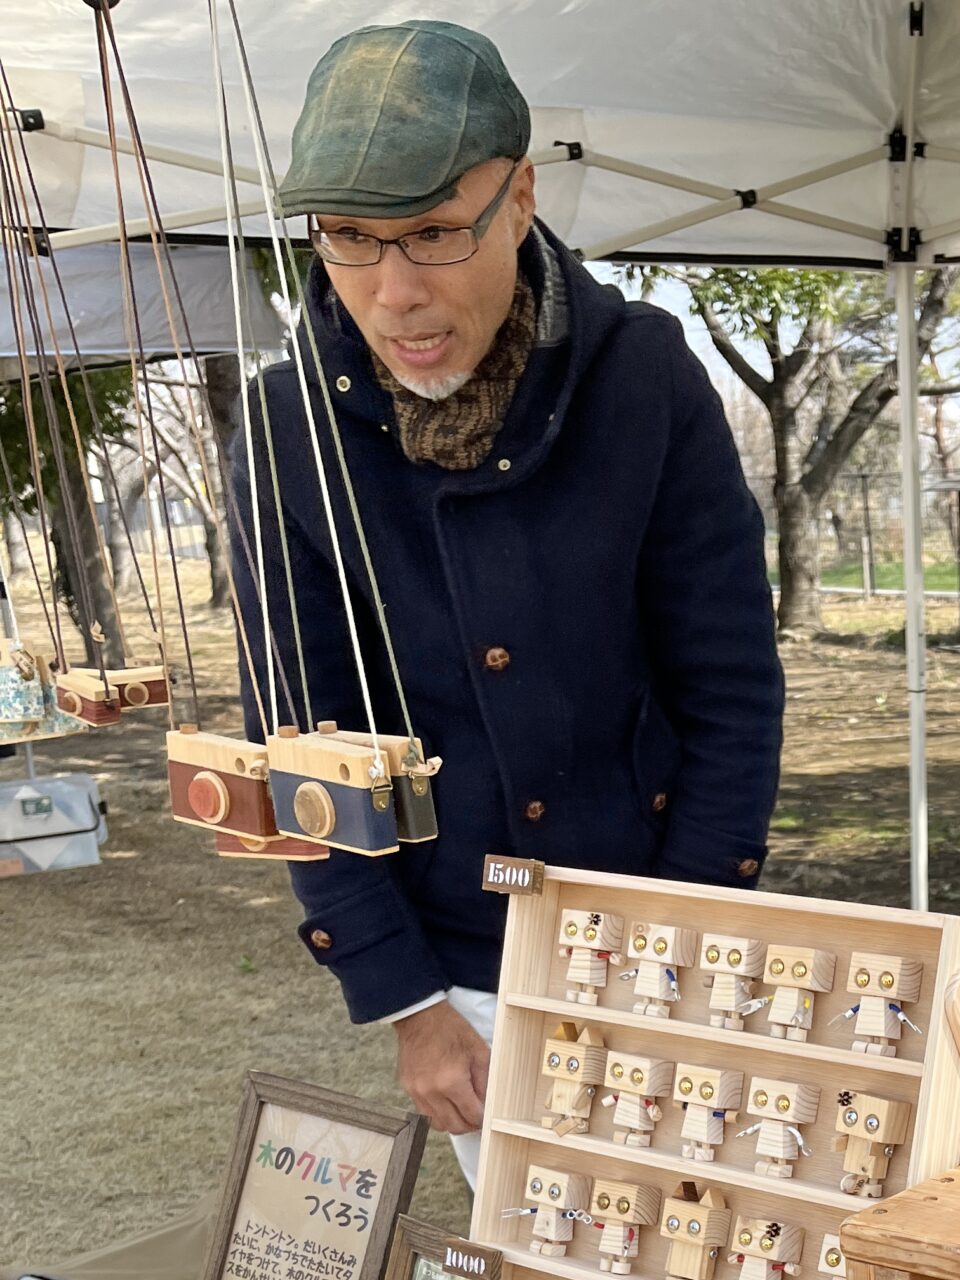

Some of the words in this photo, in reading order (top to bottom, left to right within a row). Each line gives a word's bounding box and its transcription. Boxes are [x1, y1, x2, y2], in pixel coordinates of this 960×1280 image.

[488, 863, 529, 887] 1500
[256, 1140, 378, 1199] 木のクルマを
[305, 1195, 369, 1232] つくろう
[445, 1247, 485, 1275] 1000
